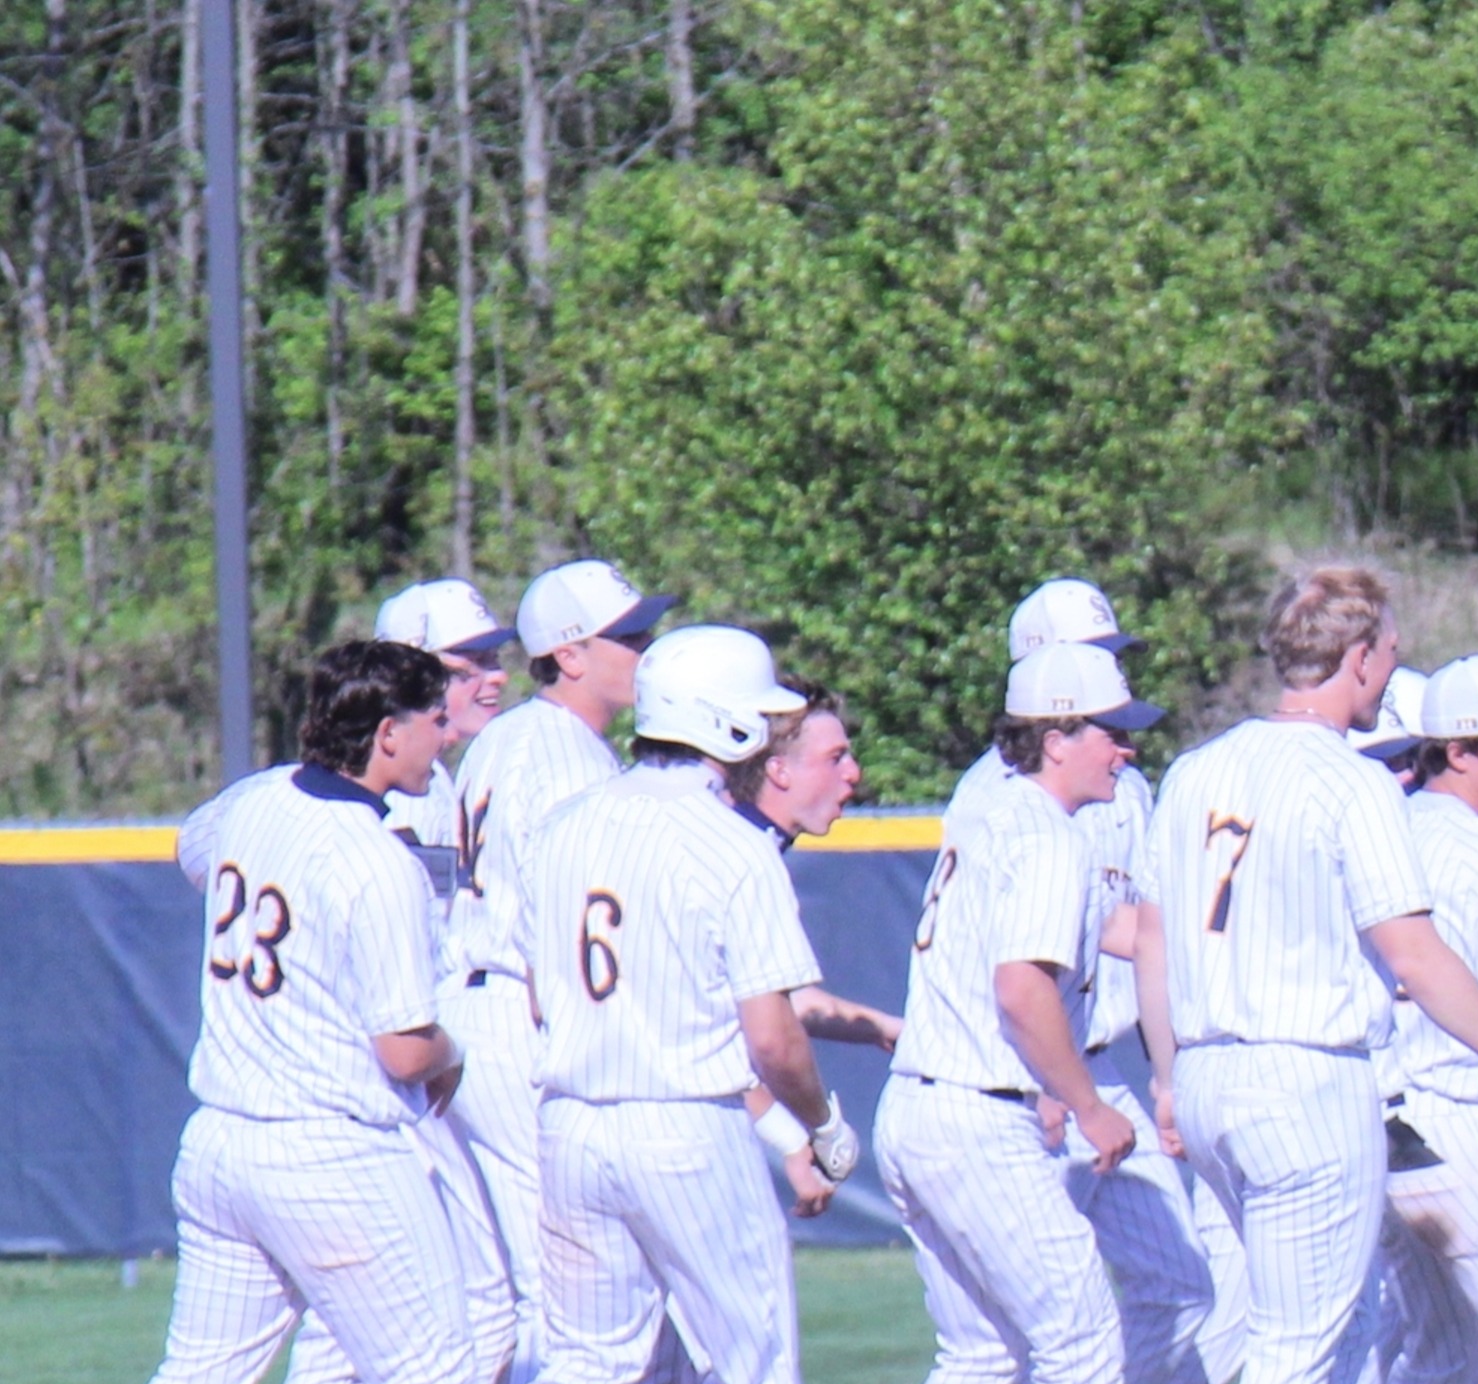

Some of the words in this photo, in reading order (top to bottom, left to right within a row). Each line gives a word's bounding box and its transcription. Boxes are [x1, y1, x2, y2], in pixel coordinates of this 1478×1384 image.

[208, 859, 292, 999] 23
[1205, 809, 1255, 935] 7
[579, 885, 623, 1004] 6
